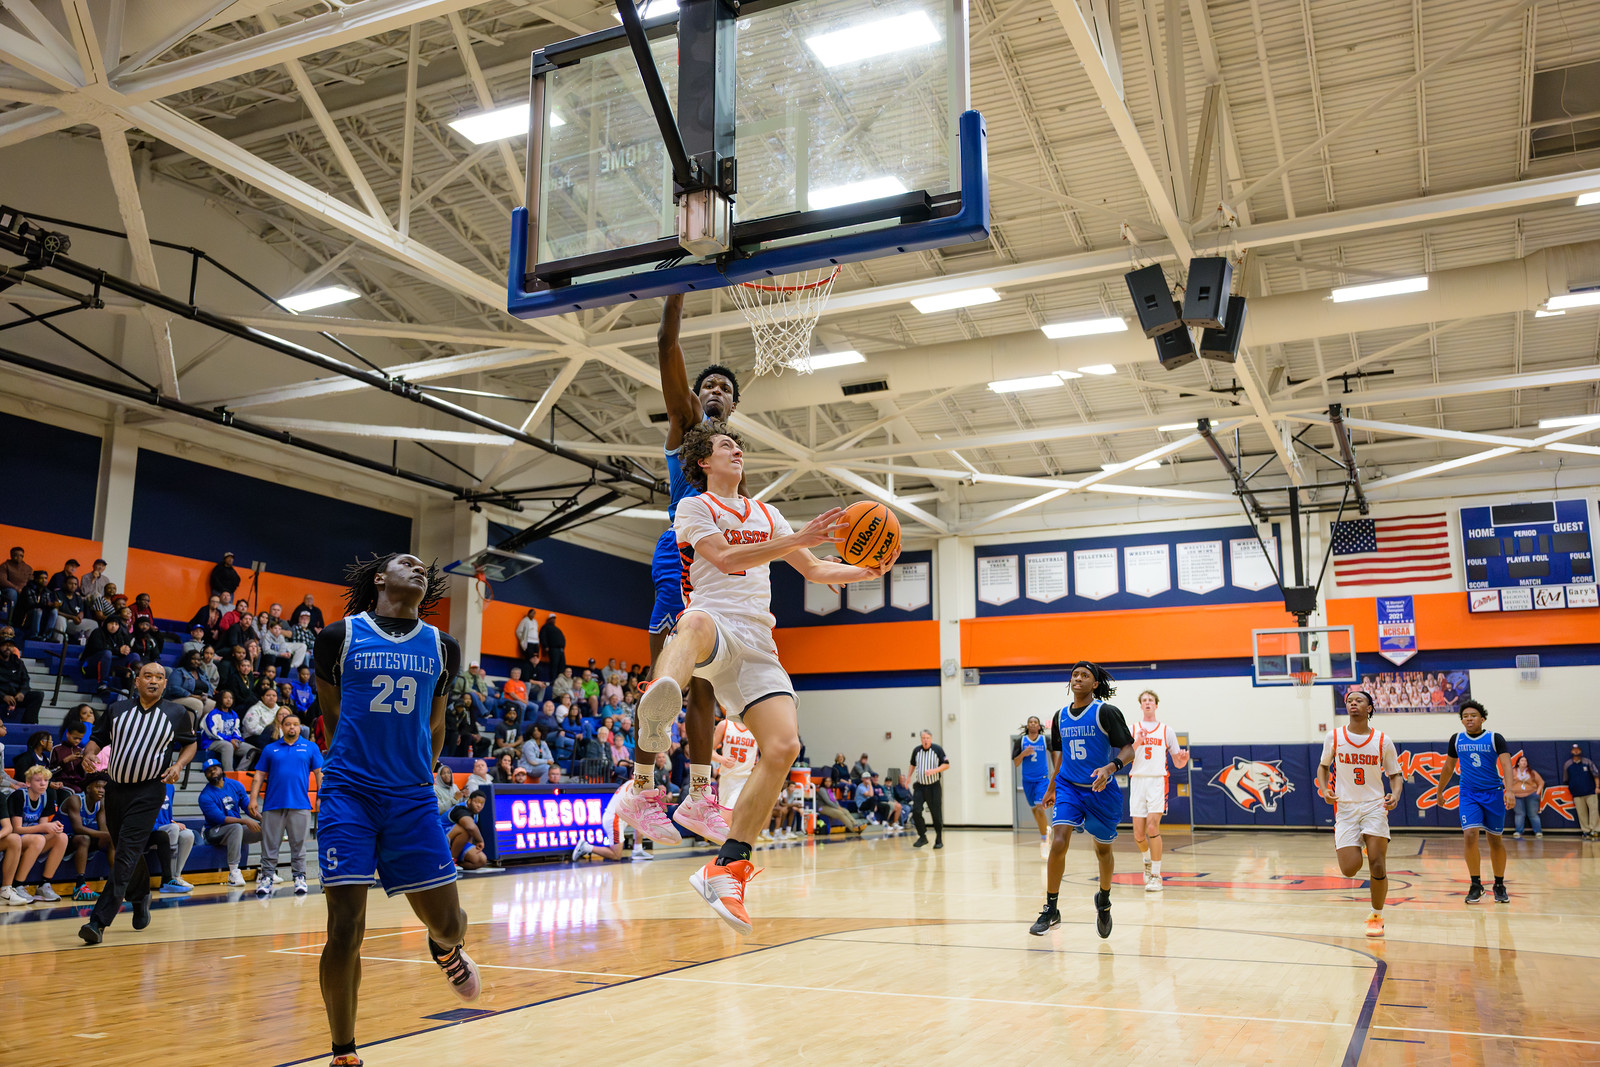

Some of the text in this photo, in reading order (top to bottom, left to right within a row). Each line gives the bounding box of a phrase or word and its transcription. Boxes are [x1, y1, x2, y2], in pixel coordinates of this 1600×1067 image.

[1468, 528, 1495, 538] HOME
[1553, 522, 1584, 532] GUEST
[849, 516, 882, 557] Wilson
[872, 531, 895, 562] NCAA
[1467, 558, 1487, 566] FOULS
[1532, 554, 1549, 562] FOUL
[1570, 552, 1591, 560] FOULS
[1383, 628, 1410, 636] NCHSAA
[354, 652, 435, 676] STATESVILLE
[370, 675, 417, 714] 23
[1061, 725, 1096, 738] STATESVILLE
[726, 735, 756, 747] CARSON
[1458, 743, 1491, 752] STATESVILLE
[730, 746, 748, 763] 55
[1069, 739, 1087, 760] 15
[1144, 747, 1152, 760] 5
[1030, 752, 1038, 762] 2
[1338, 752, 1379, 766] CARSON
[1470, 752, 1482, 767] 3
[1353, 768, 1366, 785] 3
[511, 799, 602, 829] CARSON
[515, 829, 604, 849] ATHLETICS
[327, 847, 338, 870] S
